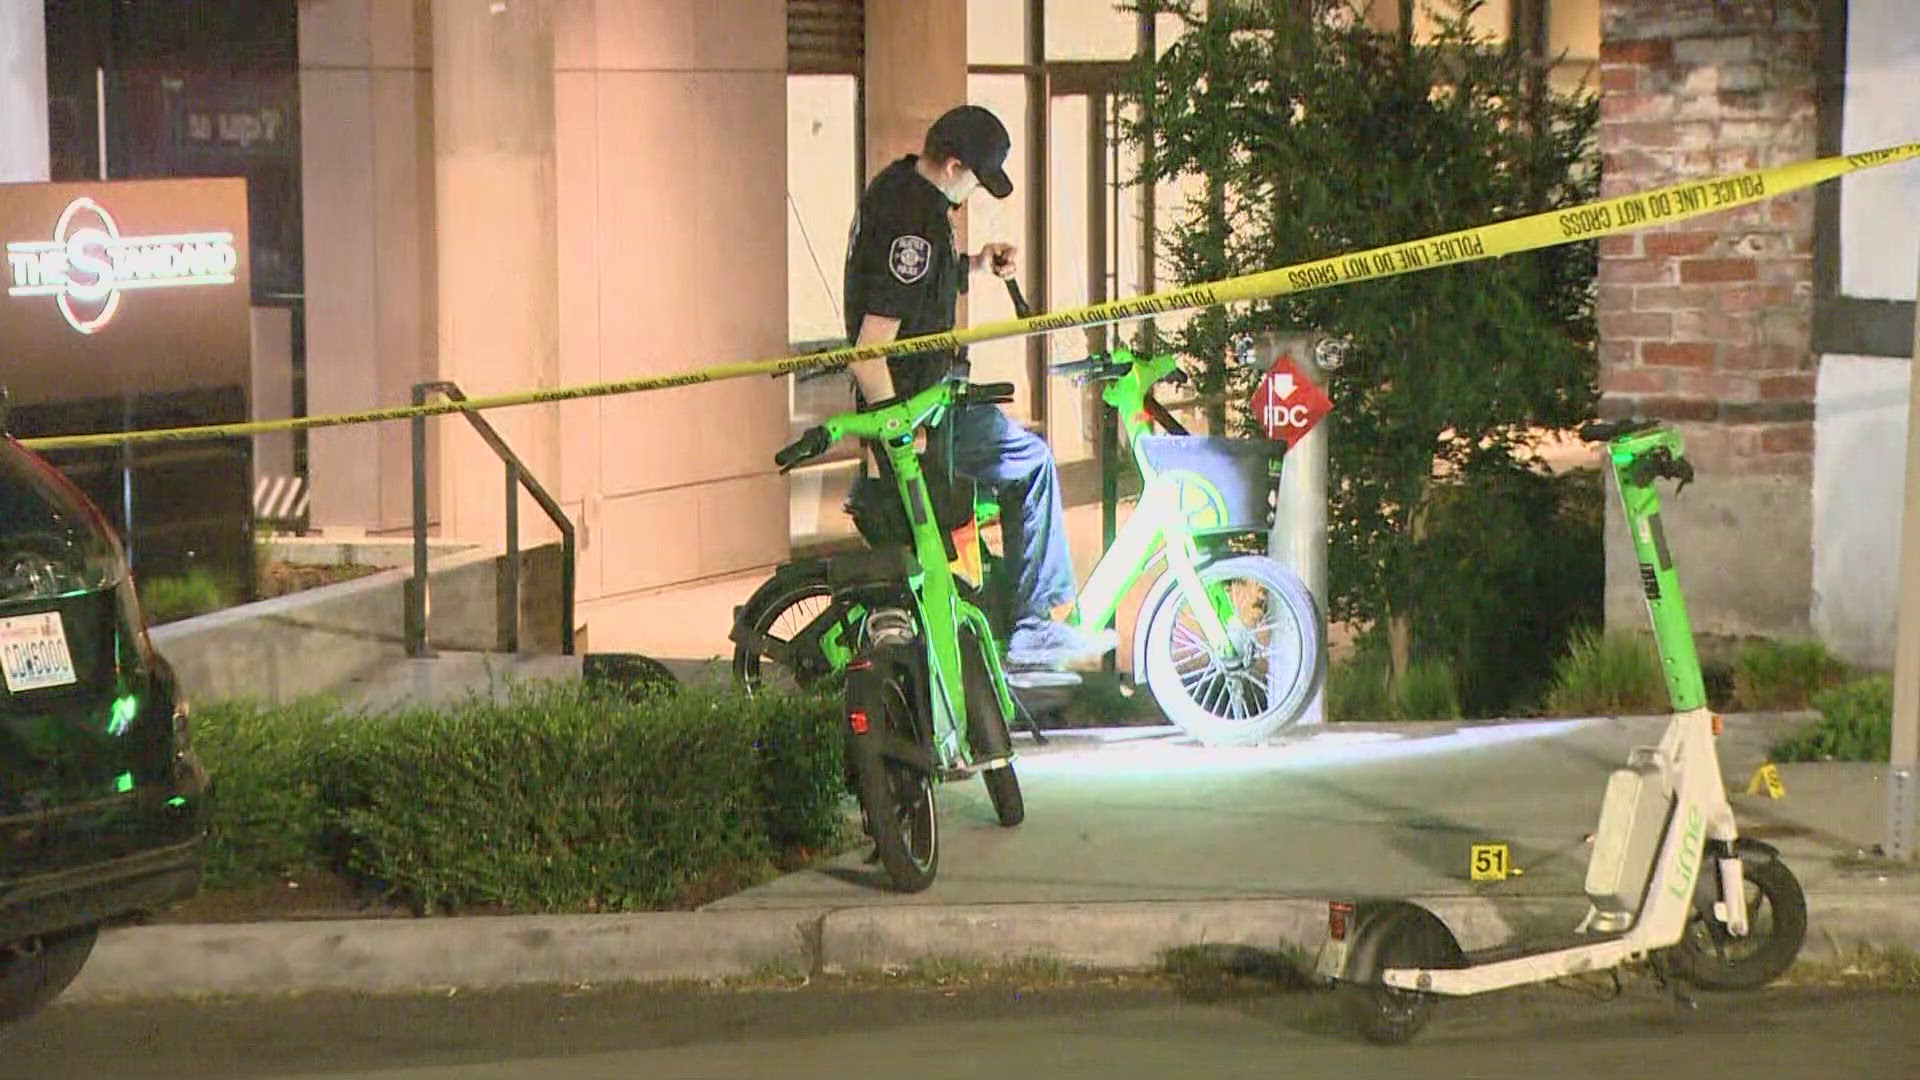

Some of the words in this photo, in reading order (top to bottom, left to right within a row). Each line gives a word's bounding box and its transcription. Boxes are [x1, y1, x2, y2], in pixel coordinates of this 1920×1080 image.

[1672, 186, 1708, 213] LINE
[1712, 174, 1765, 204] POLICE
[1616, 199, 1646, 226] NOT
[1648, 193, 1671, 218] DO
[1559, 206, 1611, 237] CROSS
[1395, 245, 1430, 269] LINE
[1431, 233, 1484, 262] POLICE
[8, 251, 67, 286] THE
[1341, 257, 1371, 280] NOT
[1373, 253, 1395, 274] DO
[1288, 264, 1339, 289] CROSS
[1132, 298, 1164, 316] LINE
[1166, 288, 1216, 309] POLICE
[1079, 309, 1107, 324] NOT
[1110, 304, 1129, 320] DO
[1476, 849, 1502, 873] 51
